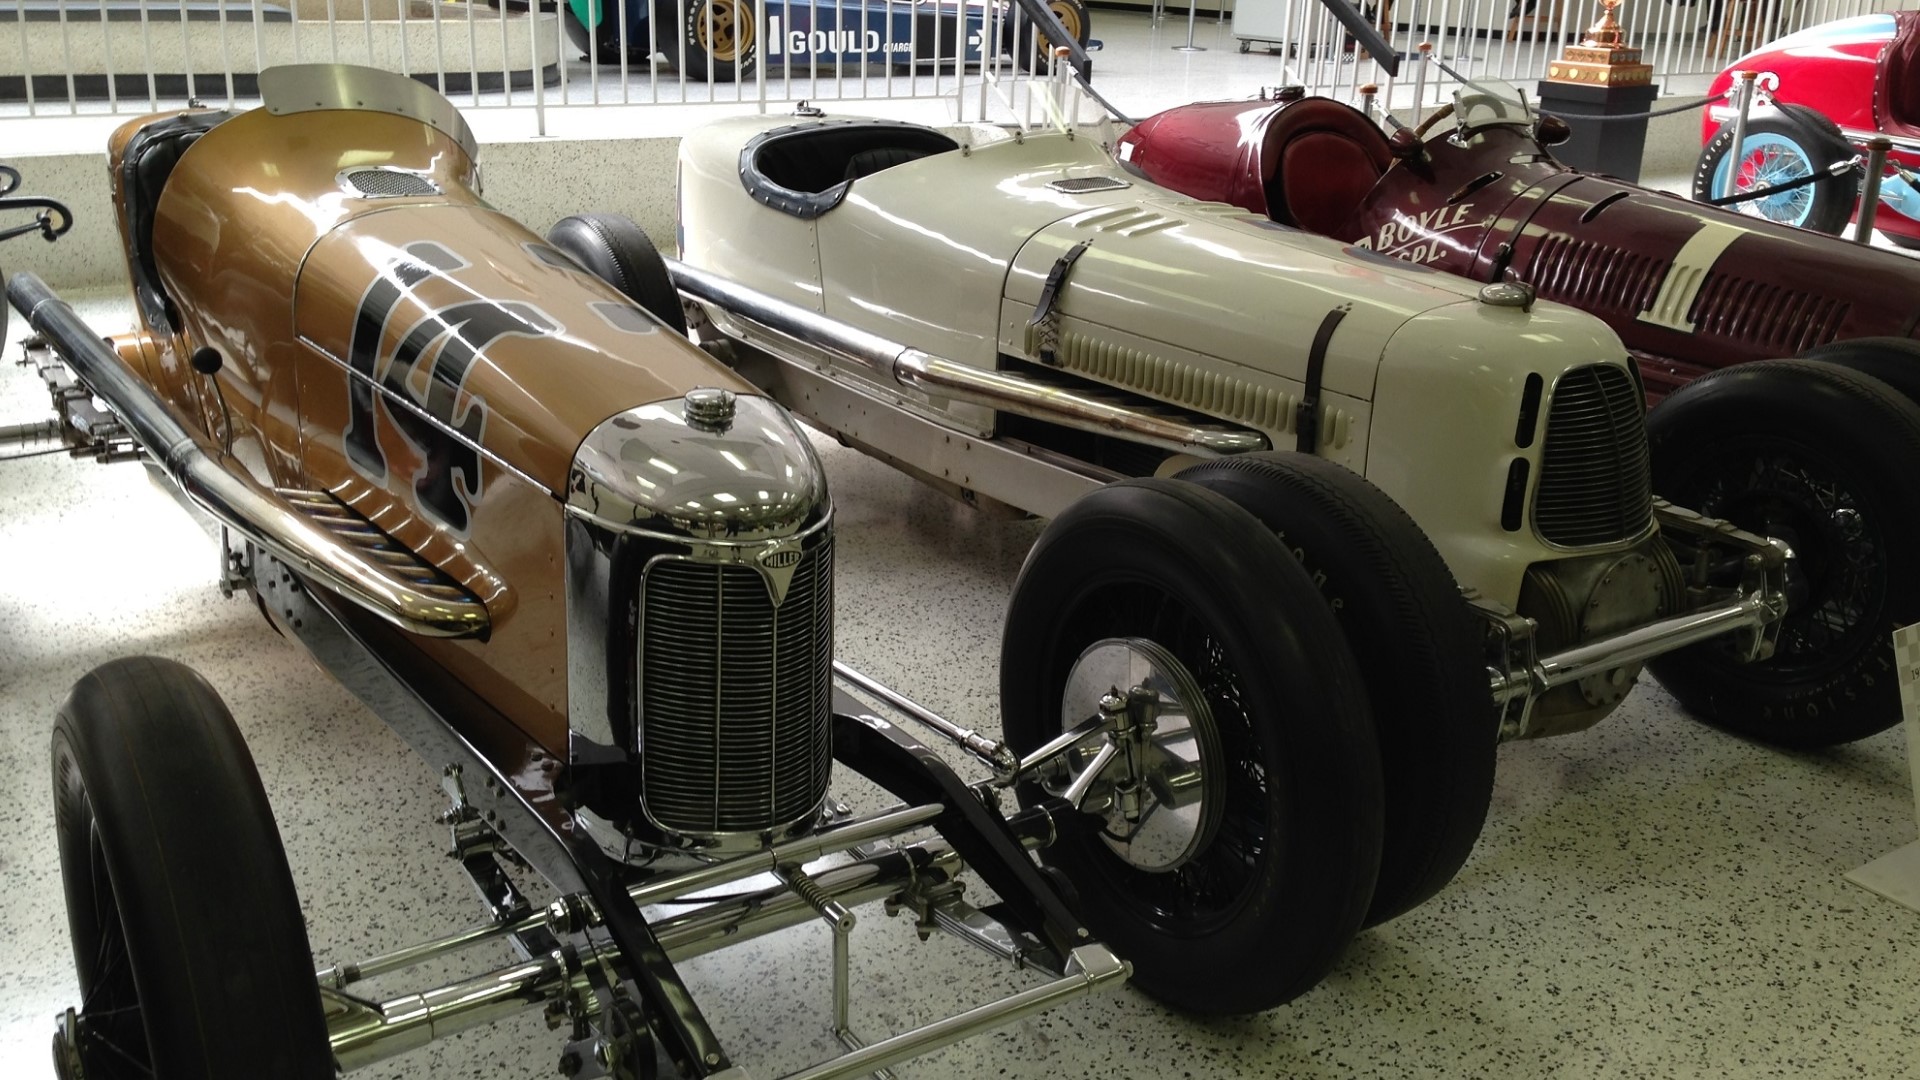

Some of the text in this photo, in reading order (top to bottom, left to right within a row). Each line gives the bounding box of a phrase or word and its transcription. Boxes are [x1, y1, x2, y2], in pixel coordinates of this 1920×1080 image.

[788, 30, 880, 55] GOULD
[1377, 203, 1475, 252] BOYLE
[765, 551, 801, 568] MILLER
